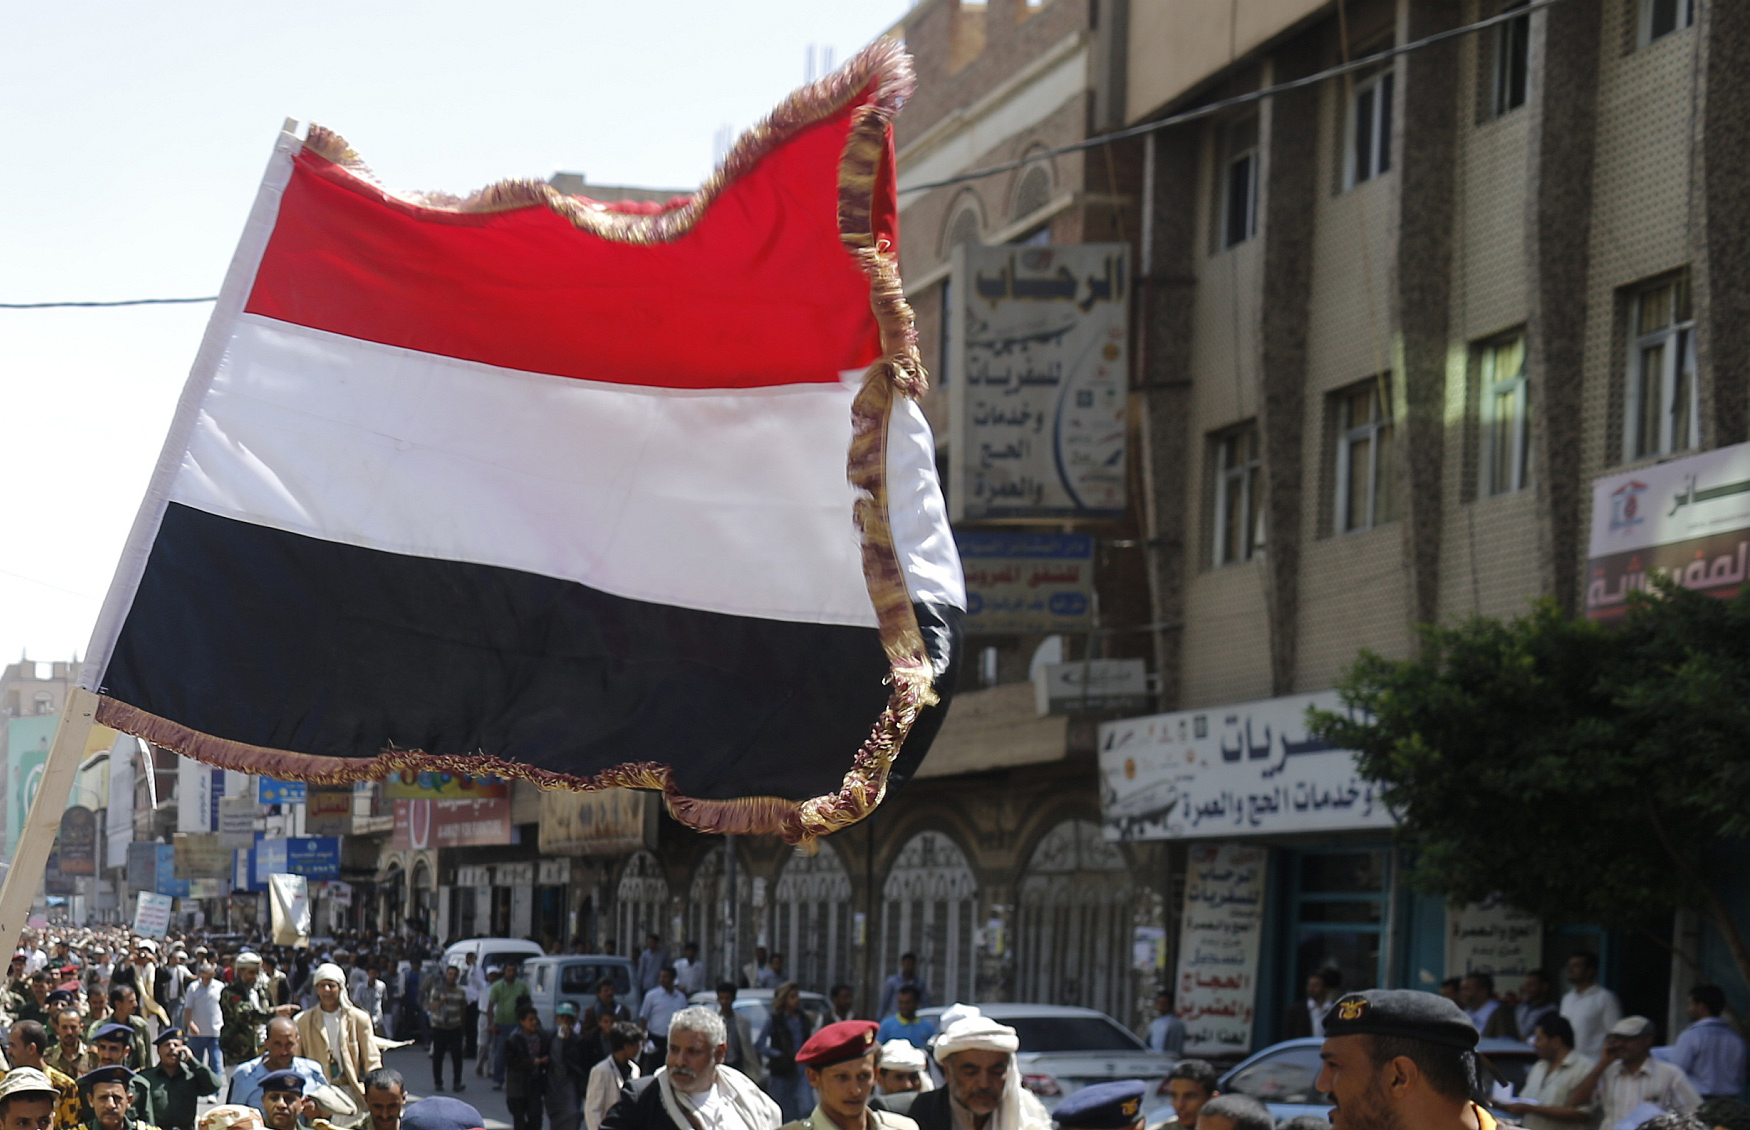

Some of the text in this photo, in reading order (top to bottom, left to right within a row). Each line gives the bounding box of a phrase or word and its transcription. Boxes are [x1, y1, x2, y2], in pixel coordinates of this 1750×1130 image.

[975, 250, 1125, 312] الرحاب
[972, 402, 1045, 433] وخدمات
[981, 439, 1031, 468] الحج
[973, 475, 1044, 506] والعمرة
[1182, 779, 1372, 828] وخدمات الحج والعمرة
